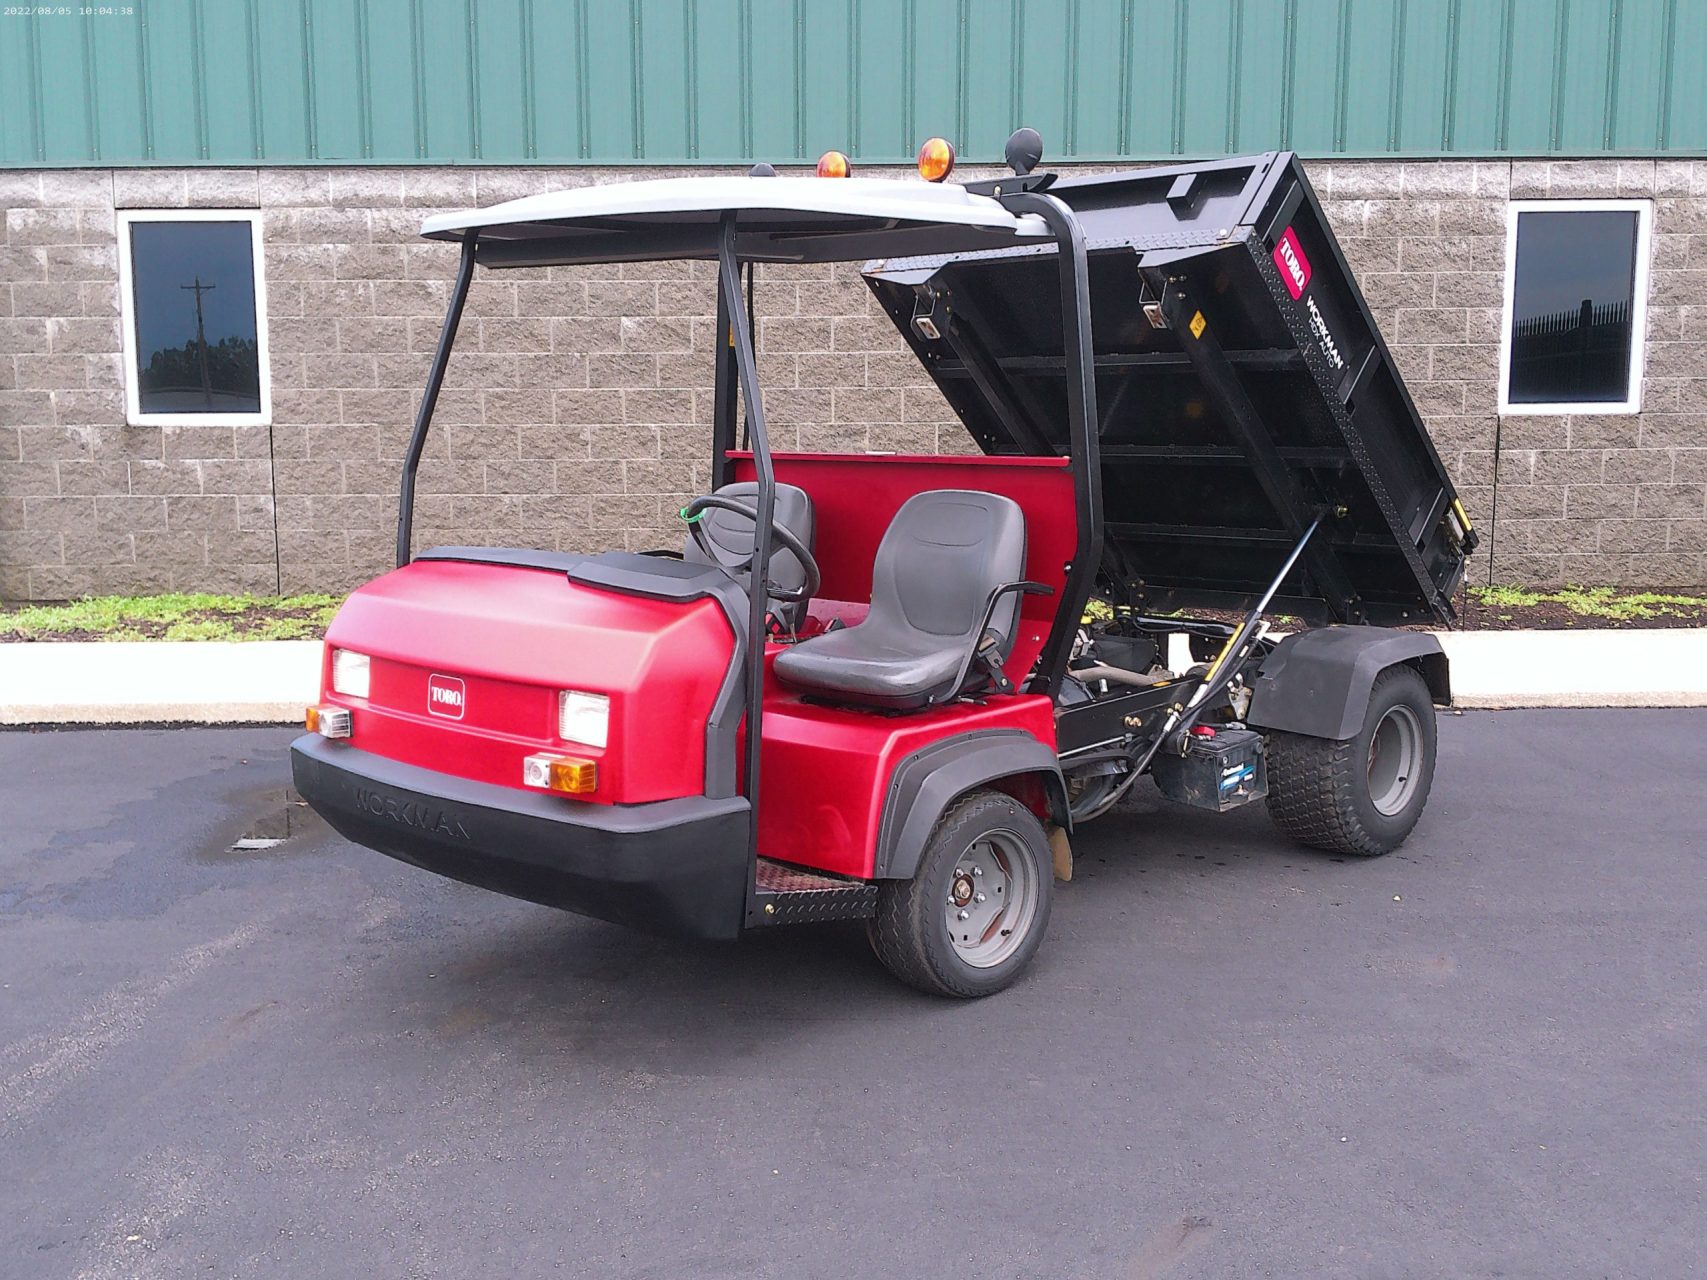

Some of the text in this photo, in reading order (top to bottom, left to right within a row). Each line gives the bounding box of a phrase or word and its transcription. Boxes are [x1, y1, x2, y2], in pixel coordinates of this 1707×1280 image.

[1280, 237, 1305, 290] TORO
[1307, 295, 1344, 370] WORKMAN
[1308, 317, 1335, 368] HDX AUTO
[431, 686, 462, 706] TORO
